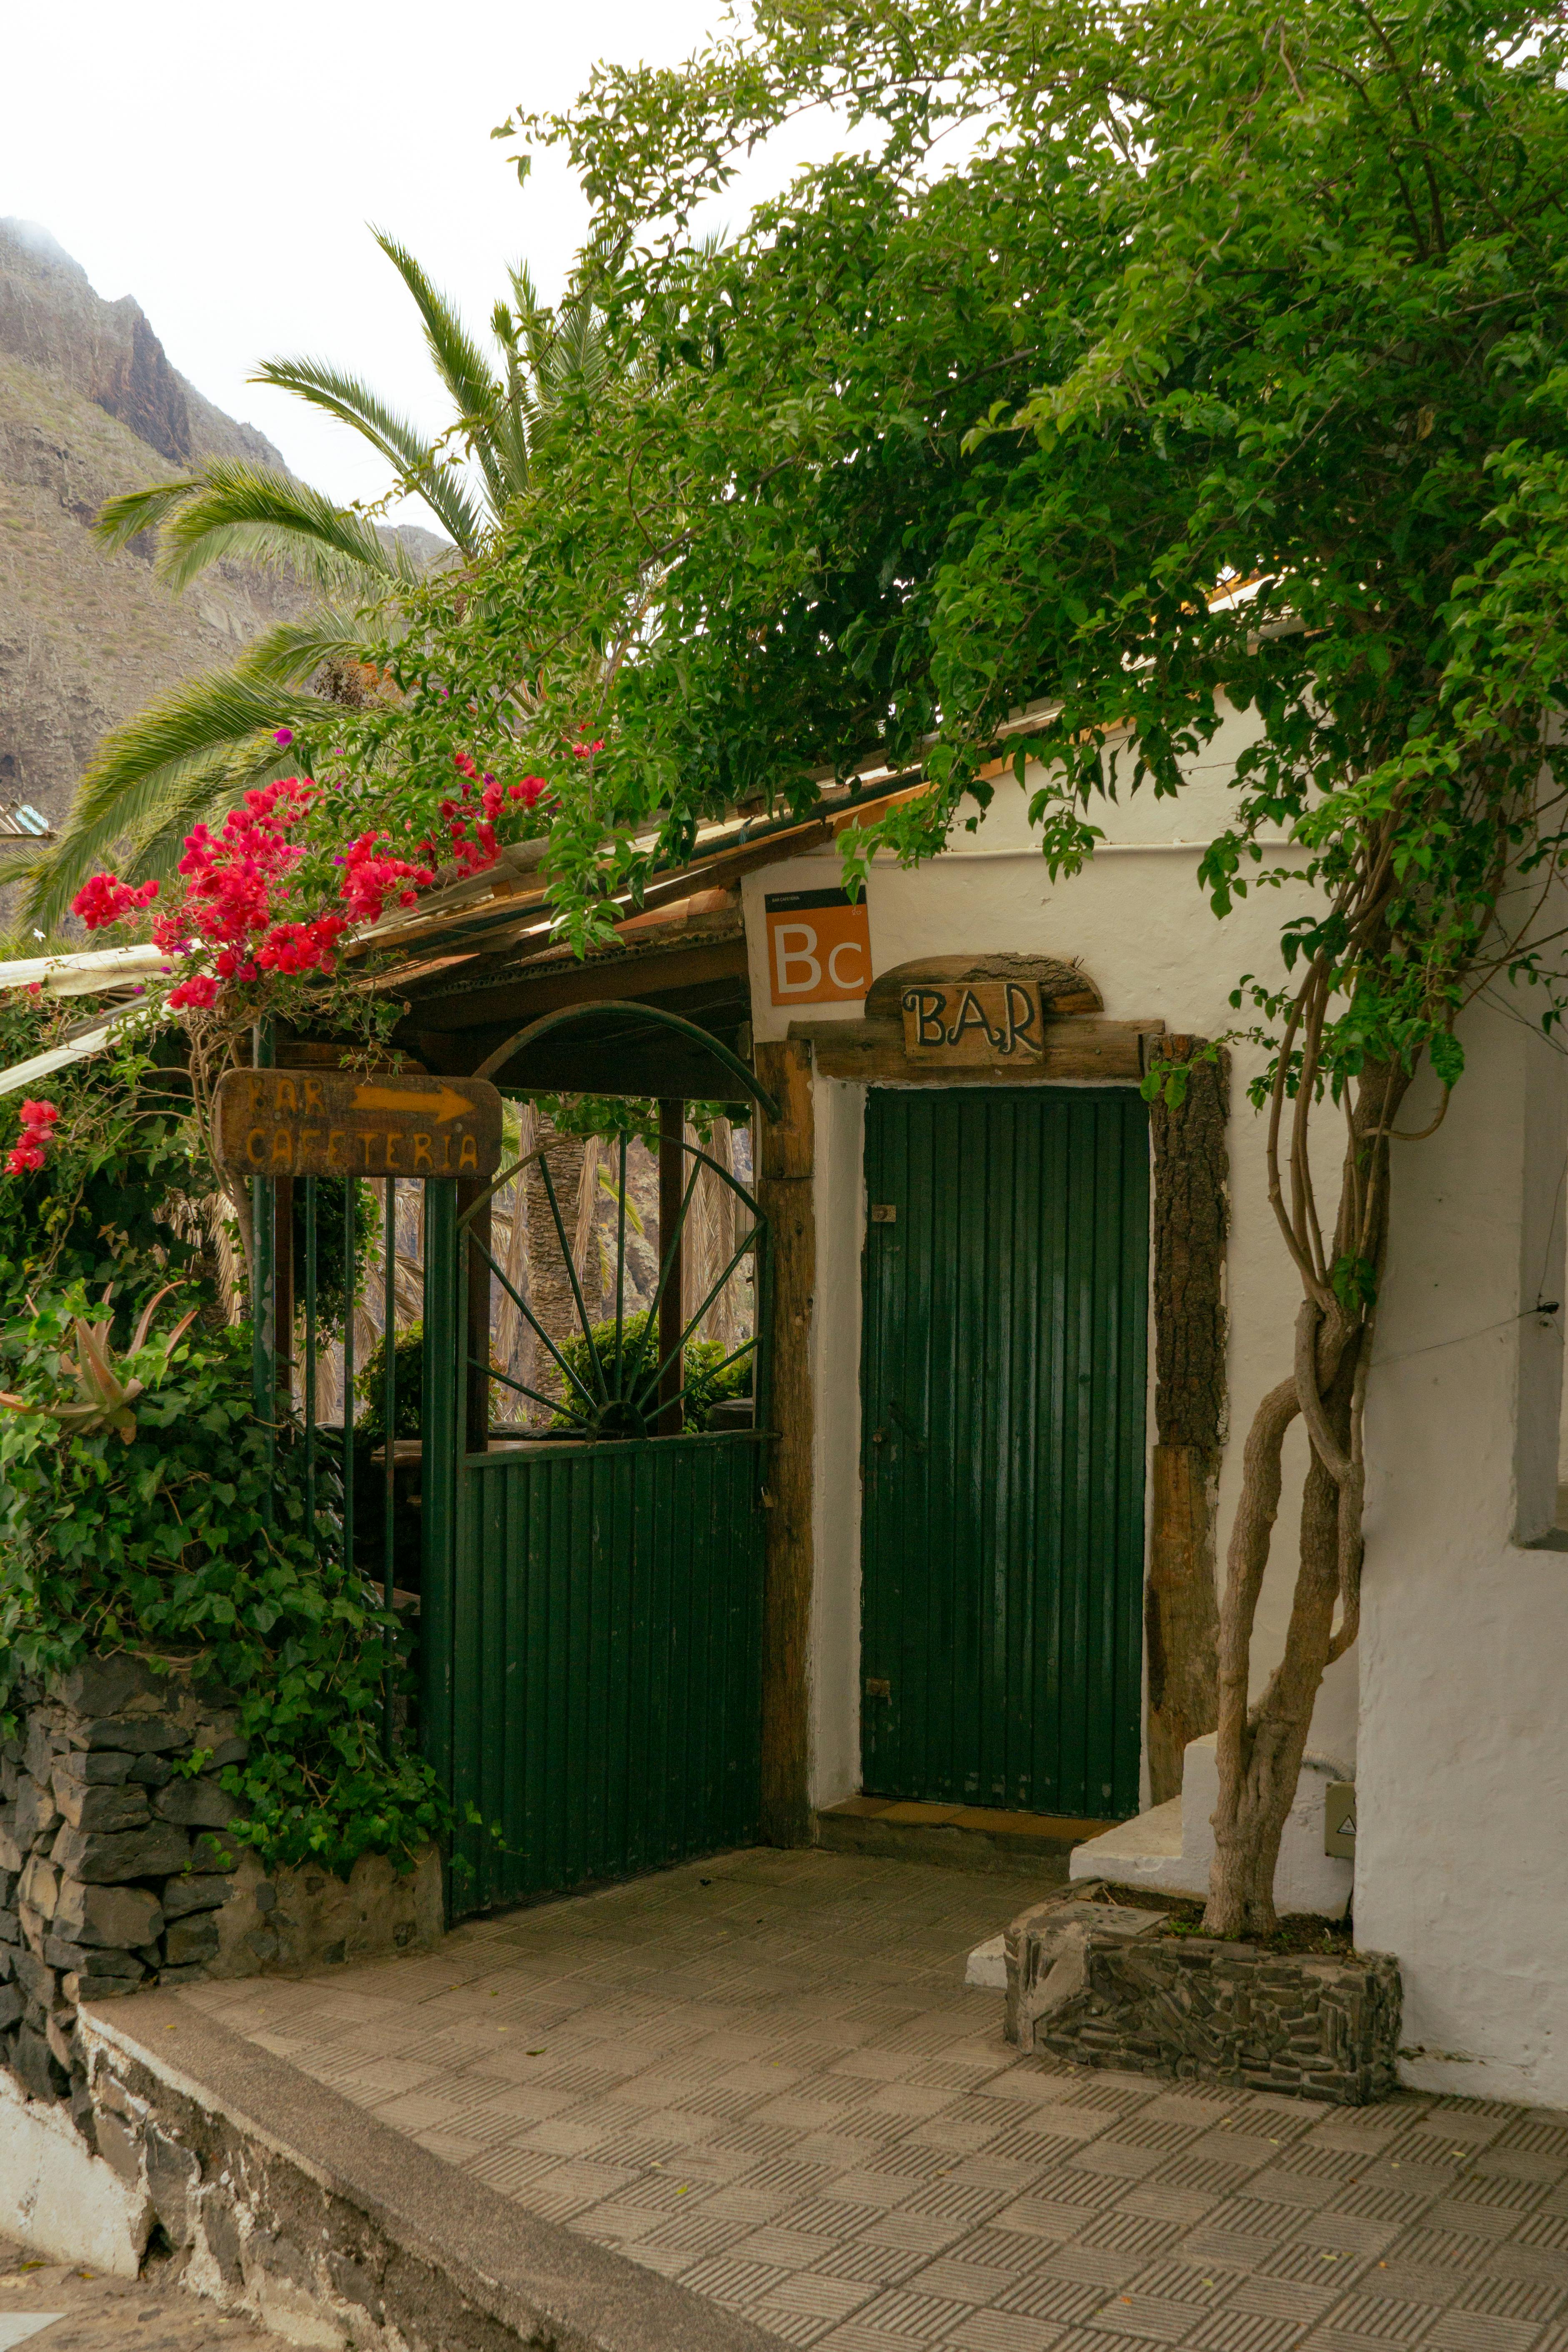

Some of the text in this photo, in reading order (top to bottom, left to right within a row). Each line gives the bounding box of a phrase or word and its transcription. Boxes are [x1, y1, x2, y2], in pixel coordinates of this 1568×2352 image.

[774, 923, 864, 994] Bc
[902, 983, 1043, 1055] BAR
[246, 1075, 327, 1116] BAR
[246, 1127, 478, 1170] CAFETERIA
